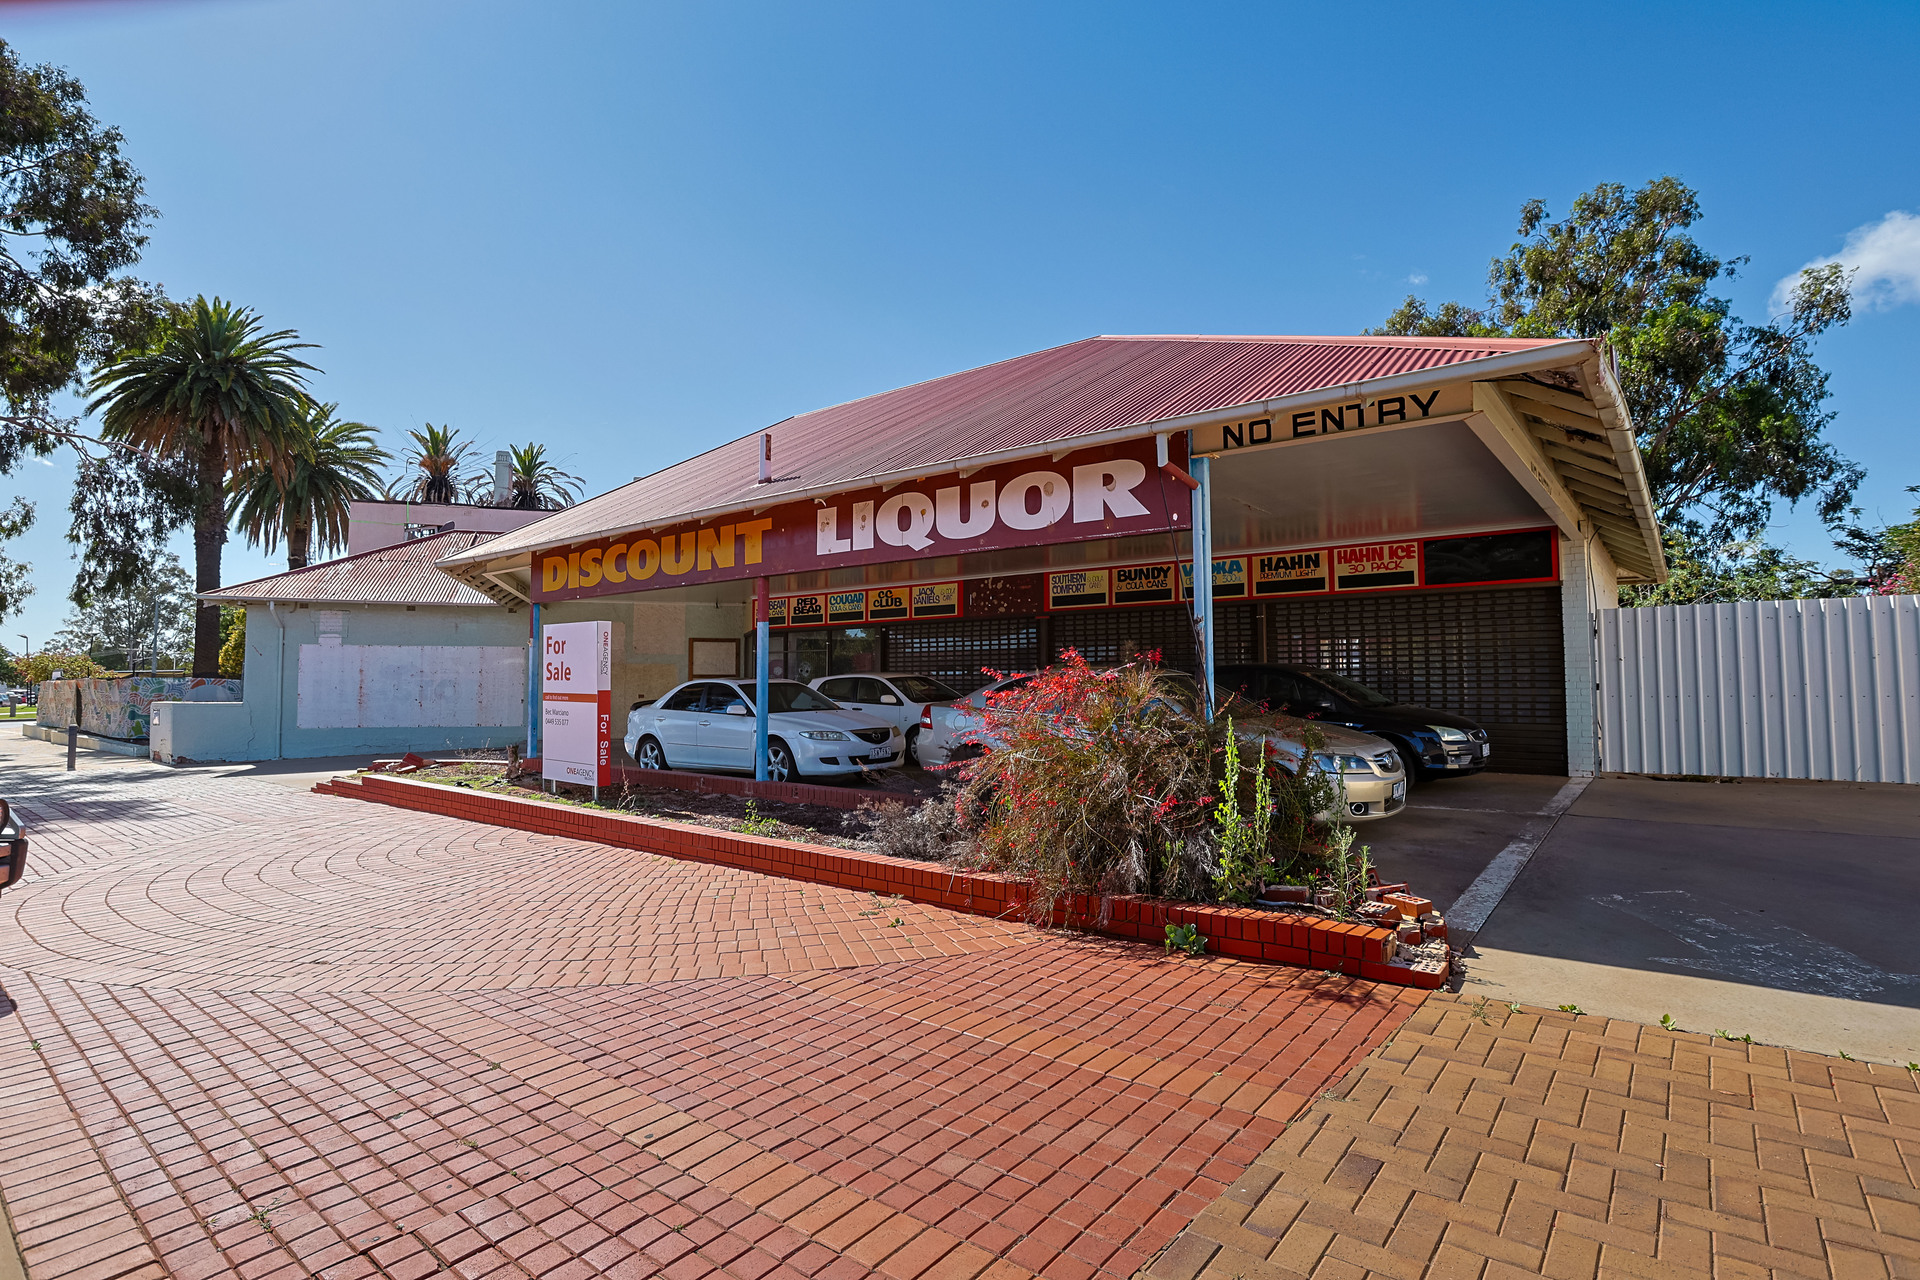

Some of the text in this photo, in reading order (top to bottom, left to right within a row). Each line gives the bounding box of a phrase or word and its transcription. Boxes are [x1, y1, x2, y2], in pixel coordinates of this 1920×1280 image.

[1222, 389, 1441, 449] NO ENTRY
[541, 458, 1151, 593] DISCOUNT LIQUOR
[1337, 543, 1416, 564] HAHN ICE
[1181, 560, 1243, 577] VKA
[1260, 553, 1320, 572] HAHN
[1348, 560, 1404, 574] 30 PACK
[1051, 573, 1087, 585] SOUTHERN
[1117, 566, 1171, 582] BUNDY
[1260, 569, 1317, 579] PREMIUM LIGHT
[1052, 583, 1086, 595] COMFORT
[1125, 581, 1145, 590] COLA
[1147, 579, 1168, 588] CANS
[878, 590, 894, 599] CC
[916, 586, 936, 597] JACK
[769, 599, 786, 611] BEAM
[797, 597, 818, 606] RED
[829, 593, 864, 606] COUGAR
[873, 597, 903, 608] CLUB
[913, 595, 941, 605] DANIELS
[793, 605, 822, 615] BEAR
[546, 636, 566, 655] For
[546, 661, 571, 681] Sale
[599, 714, 609, 766] For Sale
